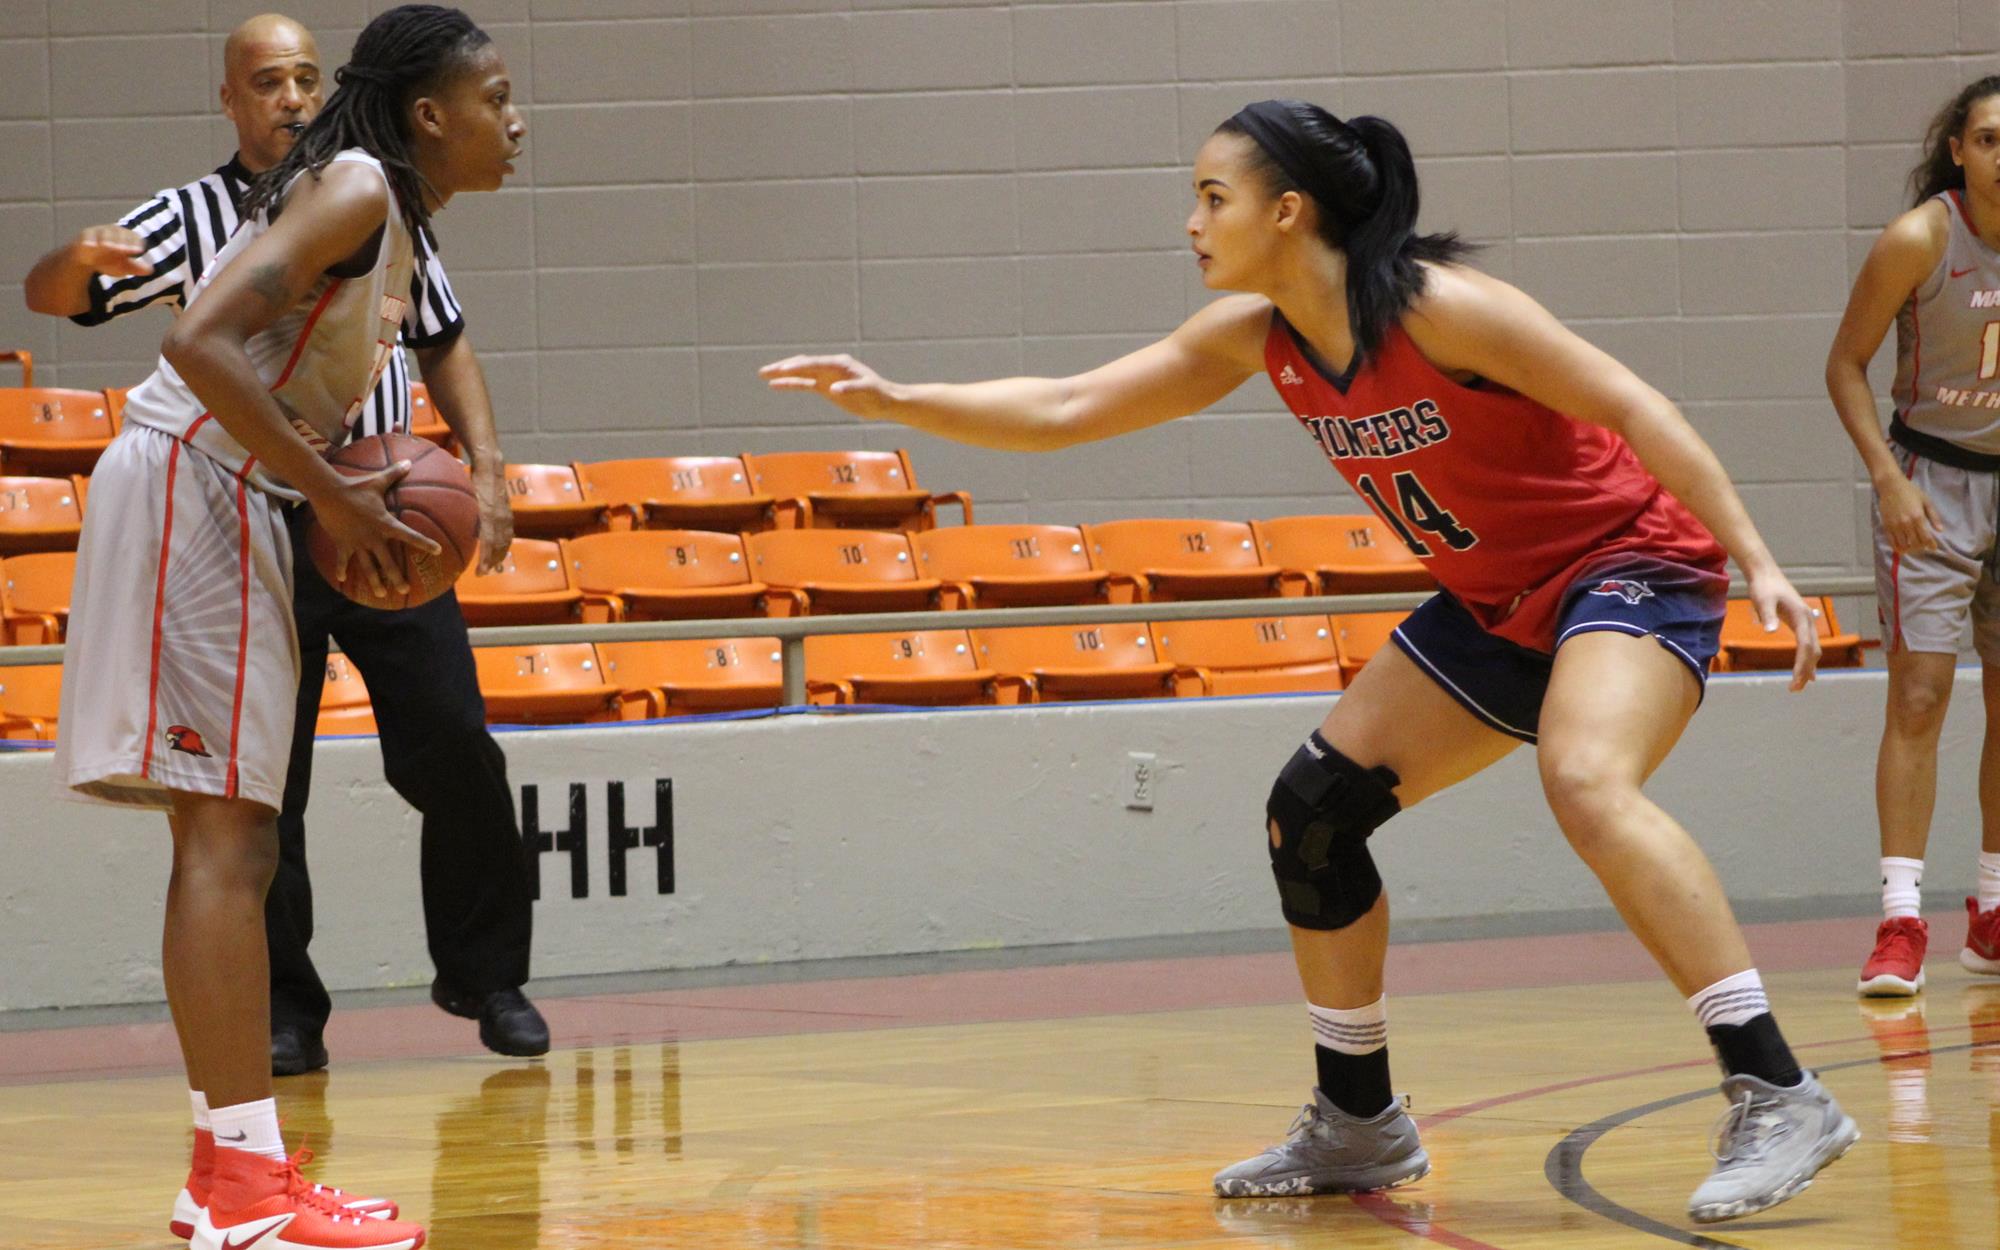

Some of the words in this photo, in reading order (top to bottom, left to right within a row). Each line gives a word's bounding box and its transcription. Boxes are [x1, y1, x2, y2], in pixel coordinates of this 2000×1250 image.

[42, 403, 53, 422] 8
[677, 471, 695, 489] 11
[835, 466, 854, 484] 12
[508, 478, 527, 495] 10
[1357, 470, 1479, 557] 14
[1186, 534, 1205, 552] 12
[1350, 530, 1369, 548] 13
[676, 548, 687, 565] 9
[843, 546, 862, 564] 10
[1016, 540, 1033, 558] 11
[1079, 631, 1098, 650] 10
[1261, 624, 1278, 642] 11
[716, 649, 727, 667] 8
[901, 640, 912, 658] 9
[327, 663, 337, 682] 6
[525, 656, 535, 674] 7
